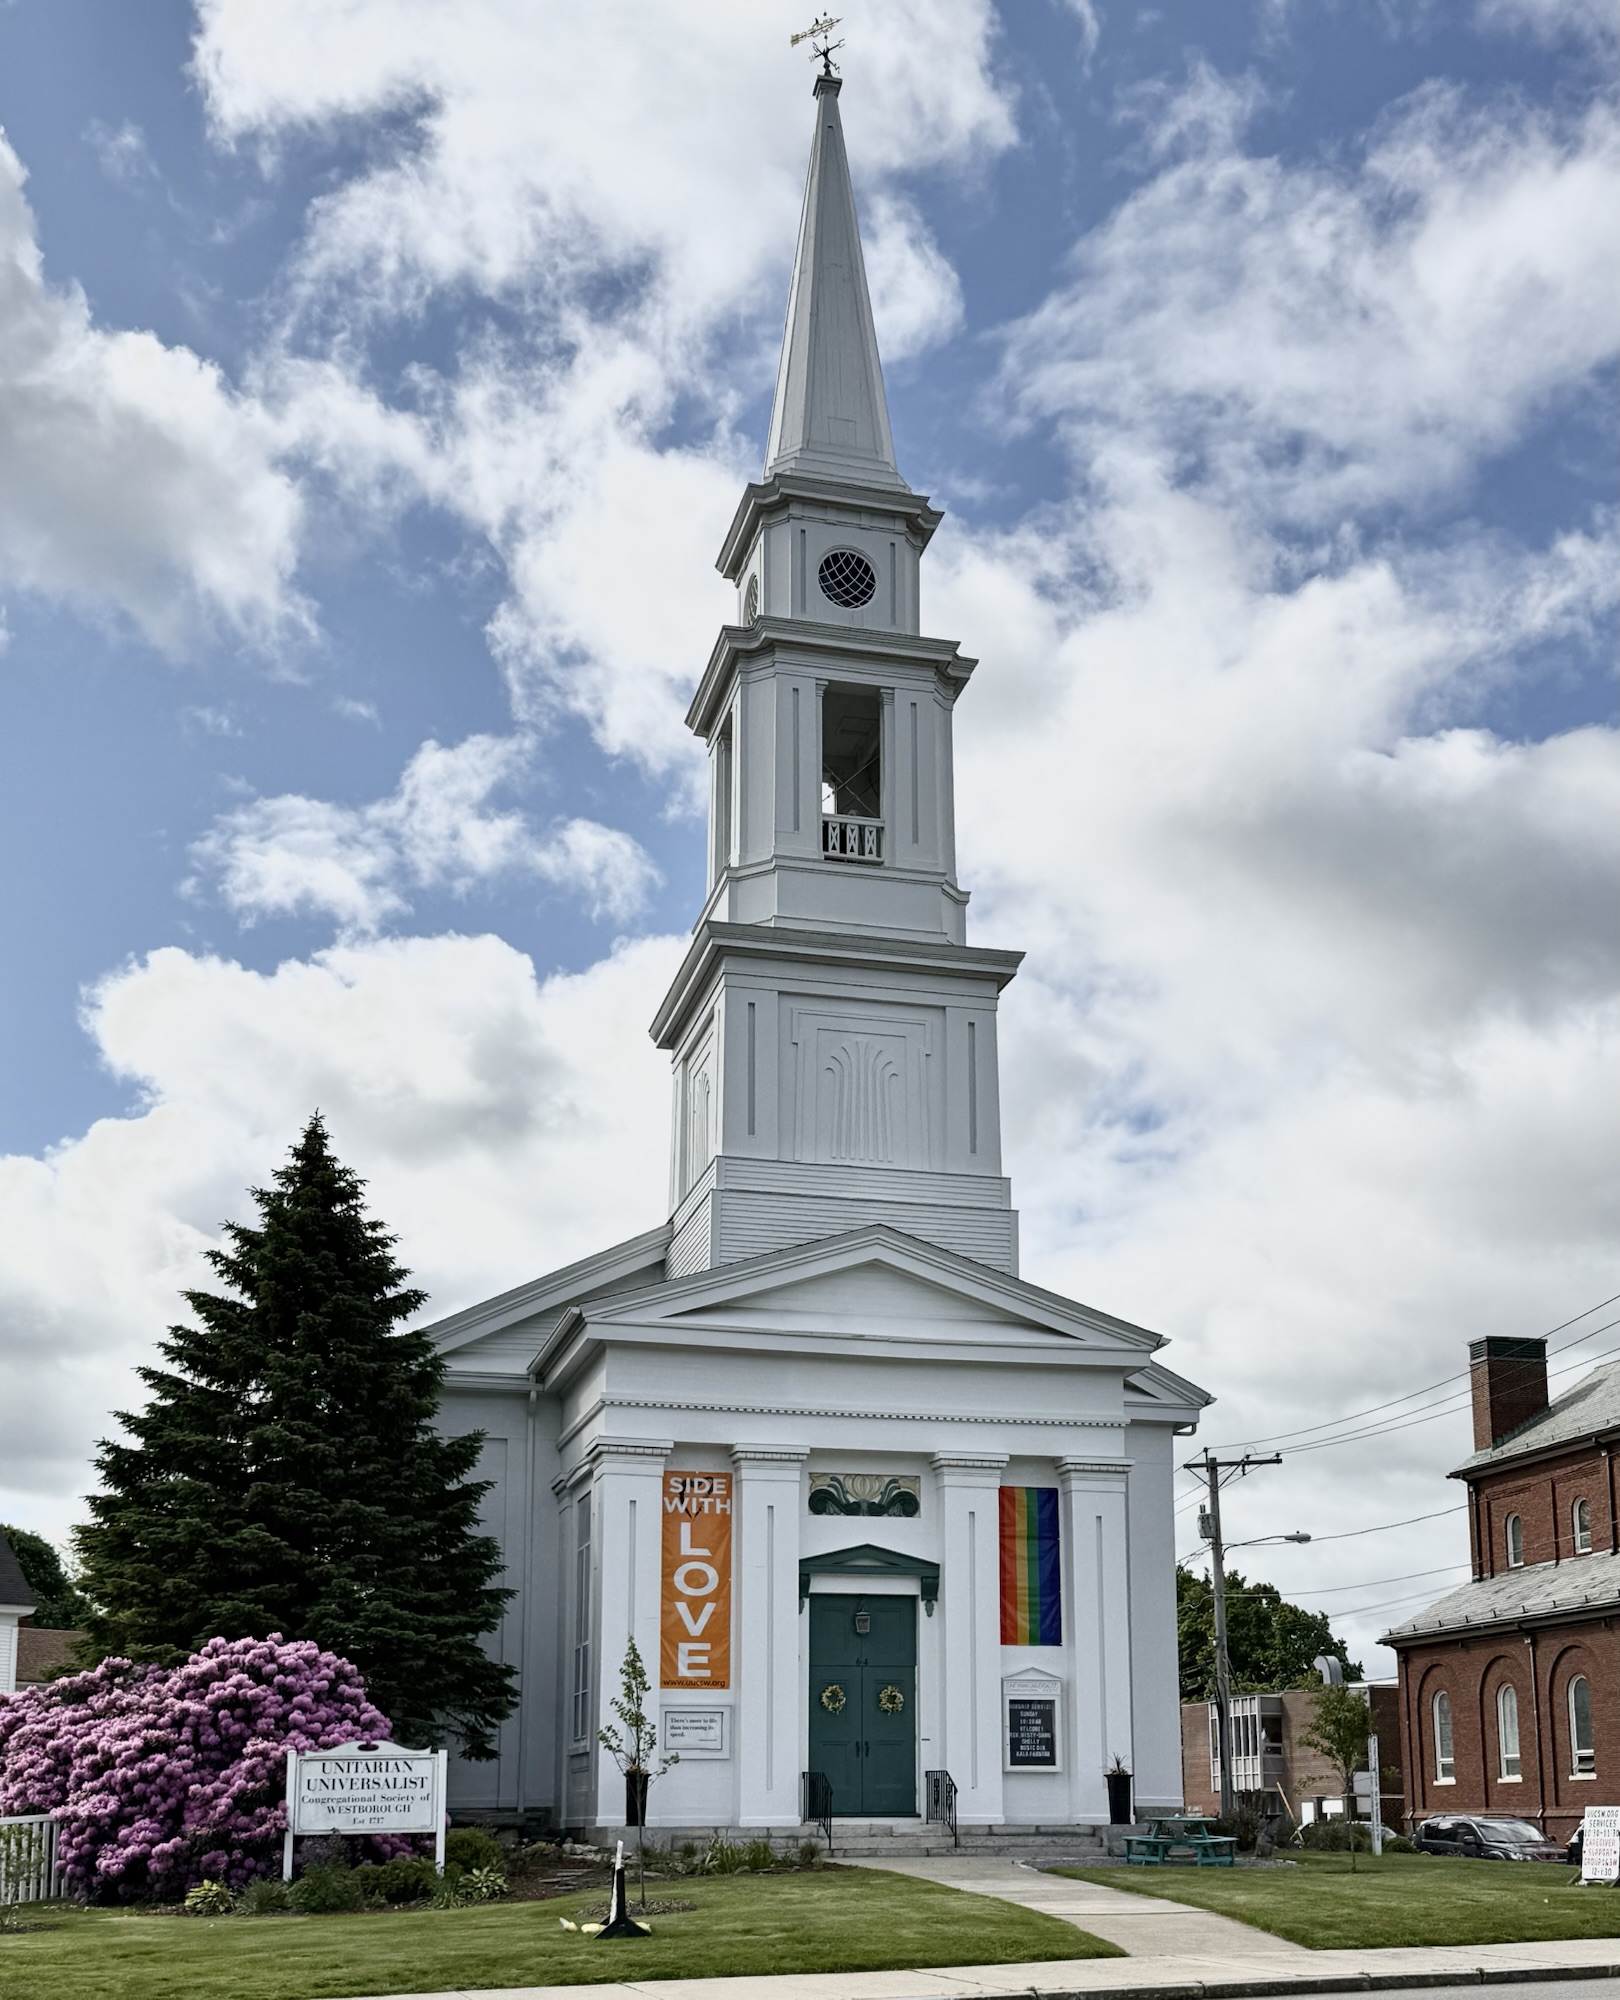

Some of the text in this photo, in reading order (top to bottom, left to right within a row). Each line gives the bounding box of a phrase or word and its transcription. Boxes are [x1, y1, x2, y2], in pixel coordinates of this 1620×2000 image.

[669, 1476, 727, 1495] SIDE
[663, 1496, 731, 1515] WITH
[673, 1522, 719, 1677] LOVE
[663, 1680, 726, 1688] www.uucsw.org
[322, 1761, 413, 1775] UNITARIAN
[307, 1776, 428, 1792] UNIVERSALIST
[301, 1793, 430, 1806] Congregational Society of
[327, 1804, 411, 1814] WESTBOROUGH
[369, 1816, 385, 1825] 1717
[1589, 1819, 1617, 1828] SERVICES
[1585, 1838, 1616, 1847] CAREGIVER
